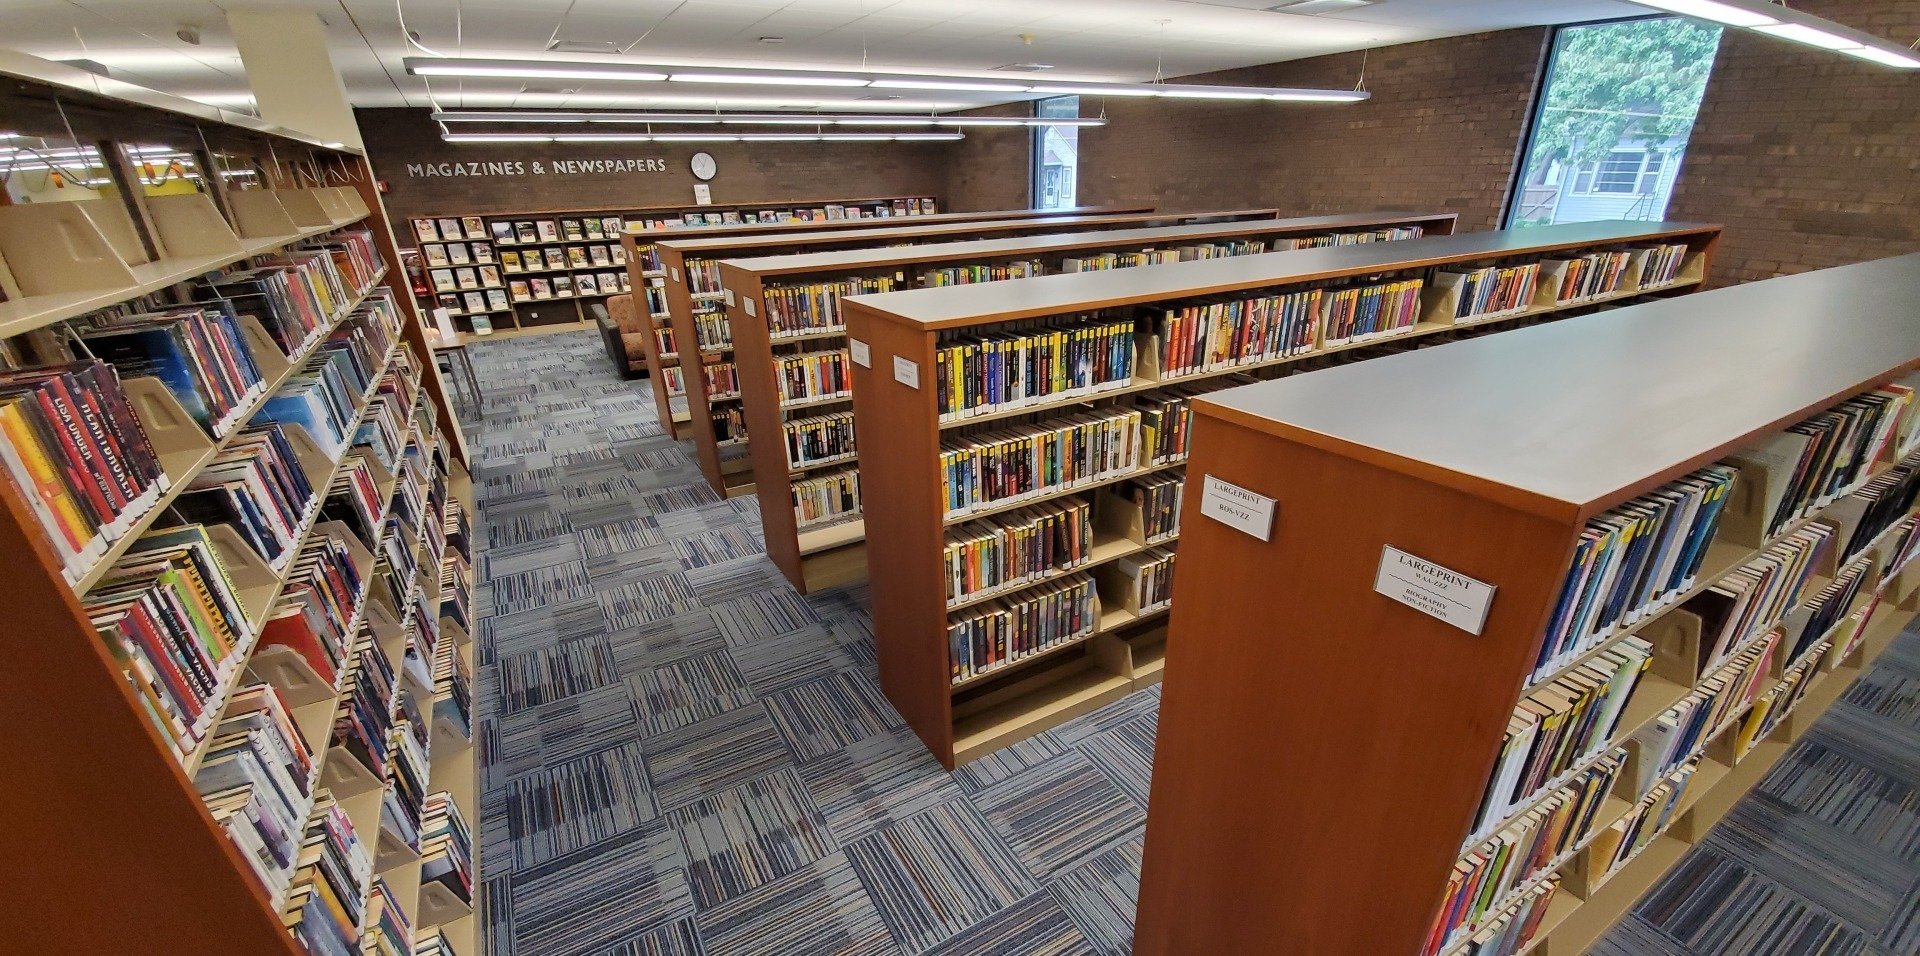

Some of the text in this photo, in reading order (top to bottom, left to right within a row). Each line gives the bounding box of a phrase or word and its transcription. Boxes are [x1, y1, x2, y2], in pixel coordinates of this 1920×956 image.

[406, 158, 667, 178] MAGAZINES & NEWSPAPERS
[54, 397, 73, 423] LISA
[1214, 483, 1260, 505] LARGEPRINT
[1219, 503, 1250, 521] ROS-VZZ
[1399, 555, 1472, 590] LARGEPRINT
[1415, 572, 1449, 591] WAA-ZZZ
[1402, 594, 1448, 618] NON-FICTION
[1405, 588, 1448, 610] BIOGRAPHY
